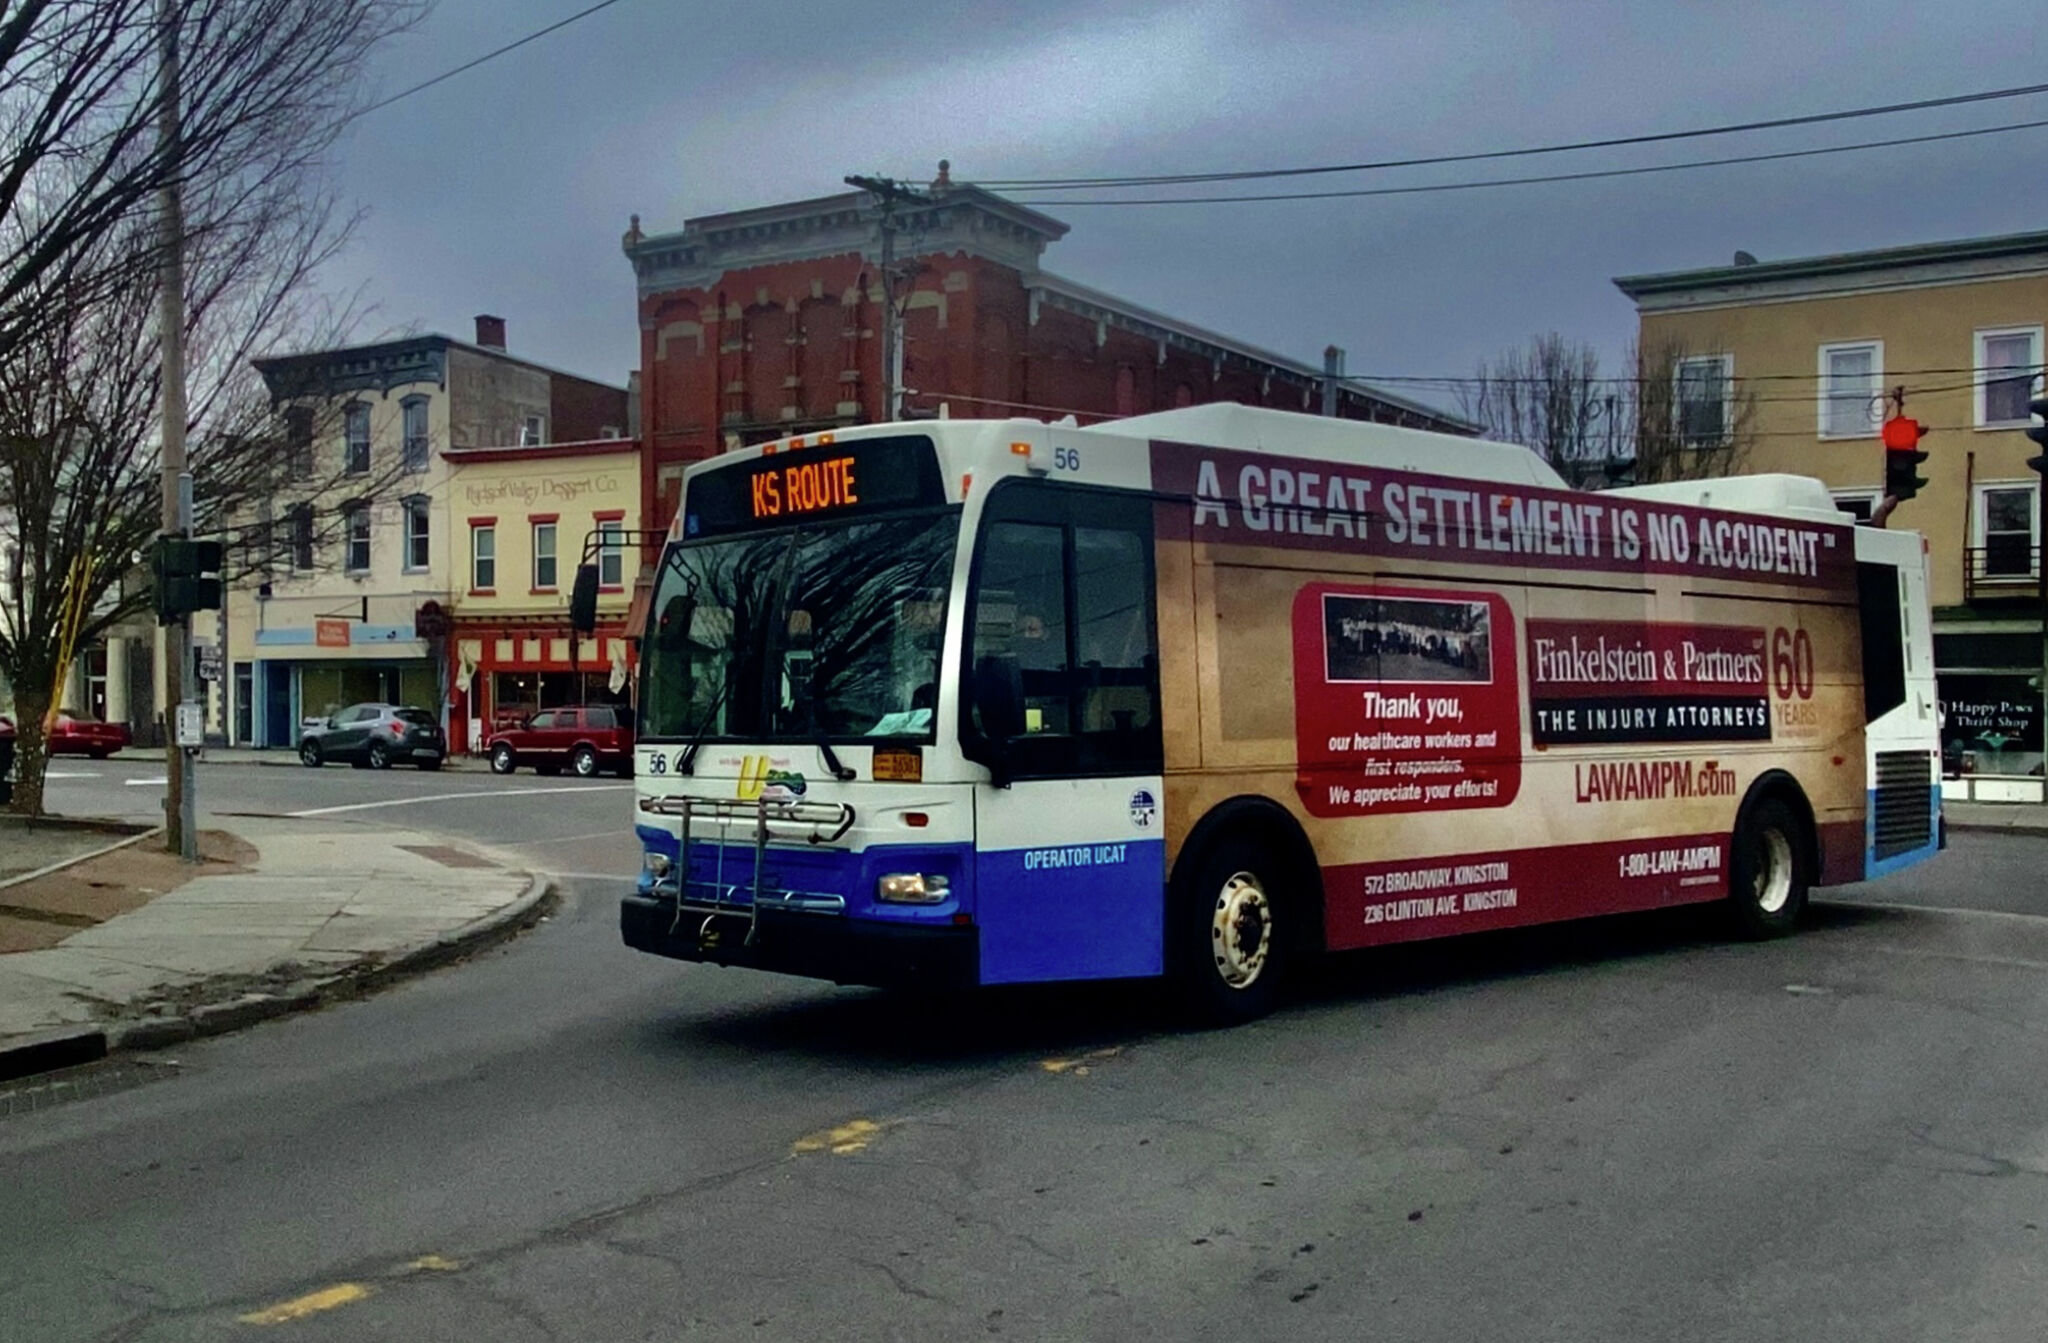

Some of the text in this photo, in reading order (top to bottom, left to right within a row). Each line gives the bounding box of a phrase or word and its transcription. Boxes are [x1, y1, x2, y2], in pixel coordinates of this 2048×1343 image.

[1055, 447, 1080, 471] 56
[752, 457, 857, 517] KS ROUTE
[1194, 460, 1229, 528] A
[1239, 465, 1372, 540] GREAT
[1383, 482, 1604, 558] SETTLEMENT
[1611, 507, 1640, 561] IS
[1648, 512, 1689, 564] NO
[1535, 636, 1763, 683] Finkelstein & Partners
[1772, 626, 1814, 700] 60
[1363, 692, 1463, 724] Thank you,
[1538, 706, 1766, 732] THE INJURY ATTORNEYS
[1775, 704, 1818, 726] YEARS
[1952, 701, 1997, 716] Happy
[1956, 716, 2028, 730] Thrift Shop
[1328, 730, 1497, 751] our healthcare workers and
[650, 754, 666, 774] 56
[1365, 758, 1392, 776] first
[1329, 779, 1498, 806] We appreciate your efforts!
[1575, 760, 1736, 803] LAWAMPM.com
[1024, 844, 1127, 870] OPERATOR UCAT
[1619, 846, 1720, 878] 1-800-LAW-AMPM
[1365, 876, 1384, 895] 572
[1454, 862, 1509, 885] KINGSTON
[1385, 898, 1434, 921] CLINTON
[1463, 888, 1517, 912] KINGSTON
